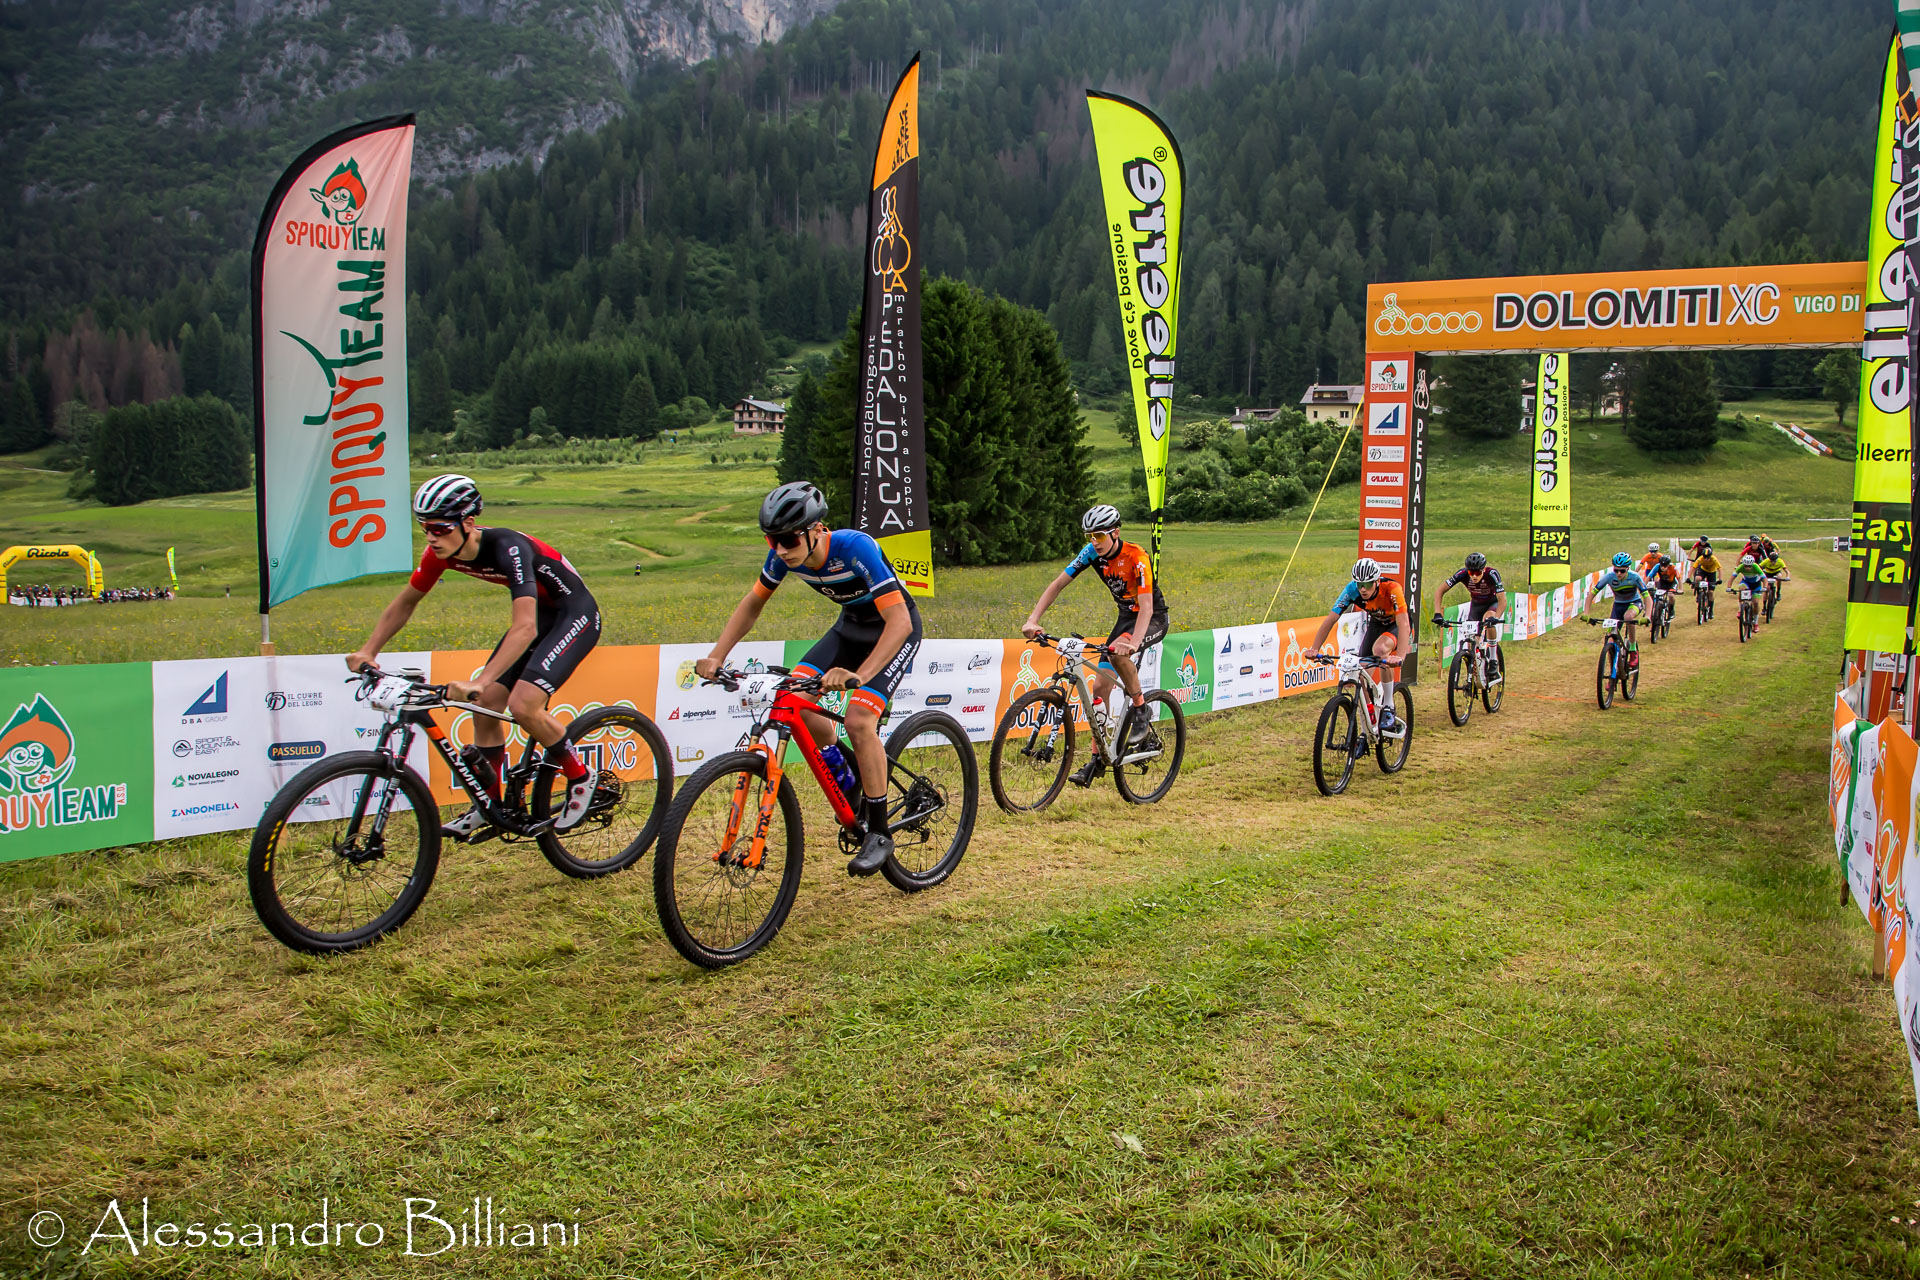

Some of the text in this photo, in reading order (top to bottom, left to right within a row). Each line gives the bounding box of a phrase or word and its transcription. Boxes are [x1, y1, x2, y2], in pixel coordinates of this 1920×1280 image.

[1495, 282, 1861, 330] DOLOMITI XC VIGO DI
[895, 294, 906, 382] marathon
[899, 393, 909, 436] bike
[903, 465, 914, 526] coppie
[1409, 418, 1424, 613] PEDALONGA
[1534, 503, 1569, 511] elleerre.it
[1533, 529, 1569, 545] Easy-
[27, 548, 69, 558] Ricola
[1533, 543, 1569, 561] Flag
[1850, 548, 1911, 584] Fla
[885, 642, 912, 677] VERONA
[1284, 666, 1326, 688] DOLOMITI
[748, 681, 764, 694] 90
[683, 709, 716, 718] alpenplus
[195, 741, 240, 750] MOUNTAIN
[272, 745, 321, 756] PASSUELLO
[608, 741, 637, 770] XC
[188, 770, 240, 781] NOVALEGNO
[171, 802, 239, 817] ZANDONELLA
[755, 812, 771, 839] FOX
